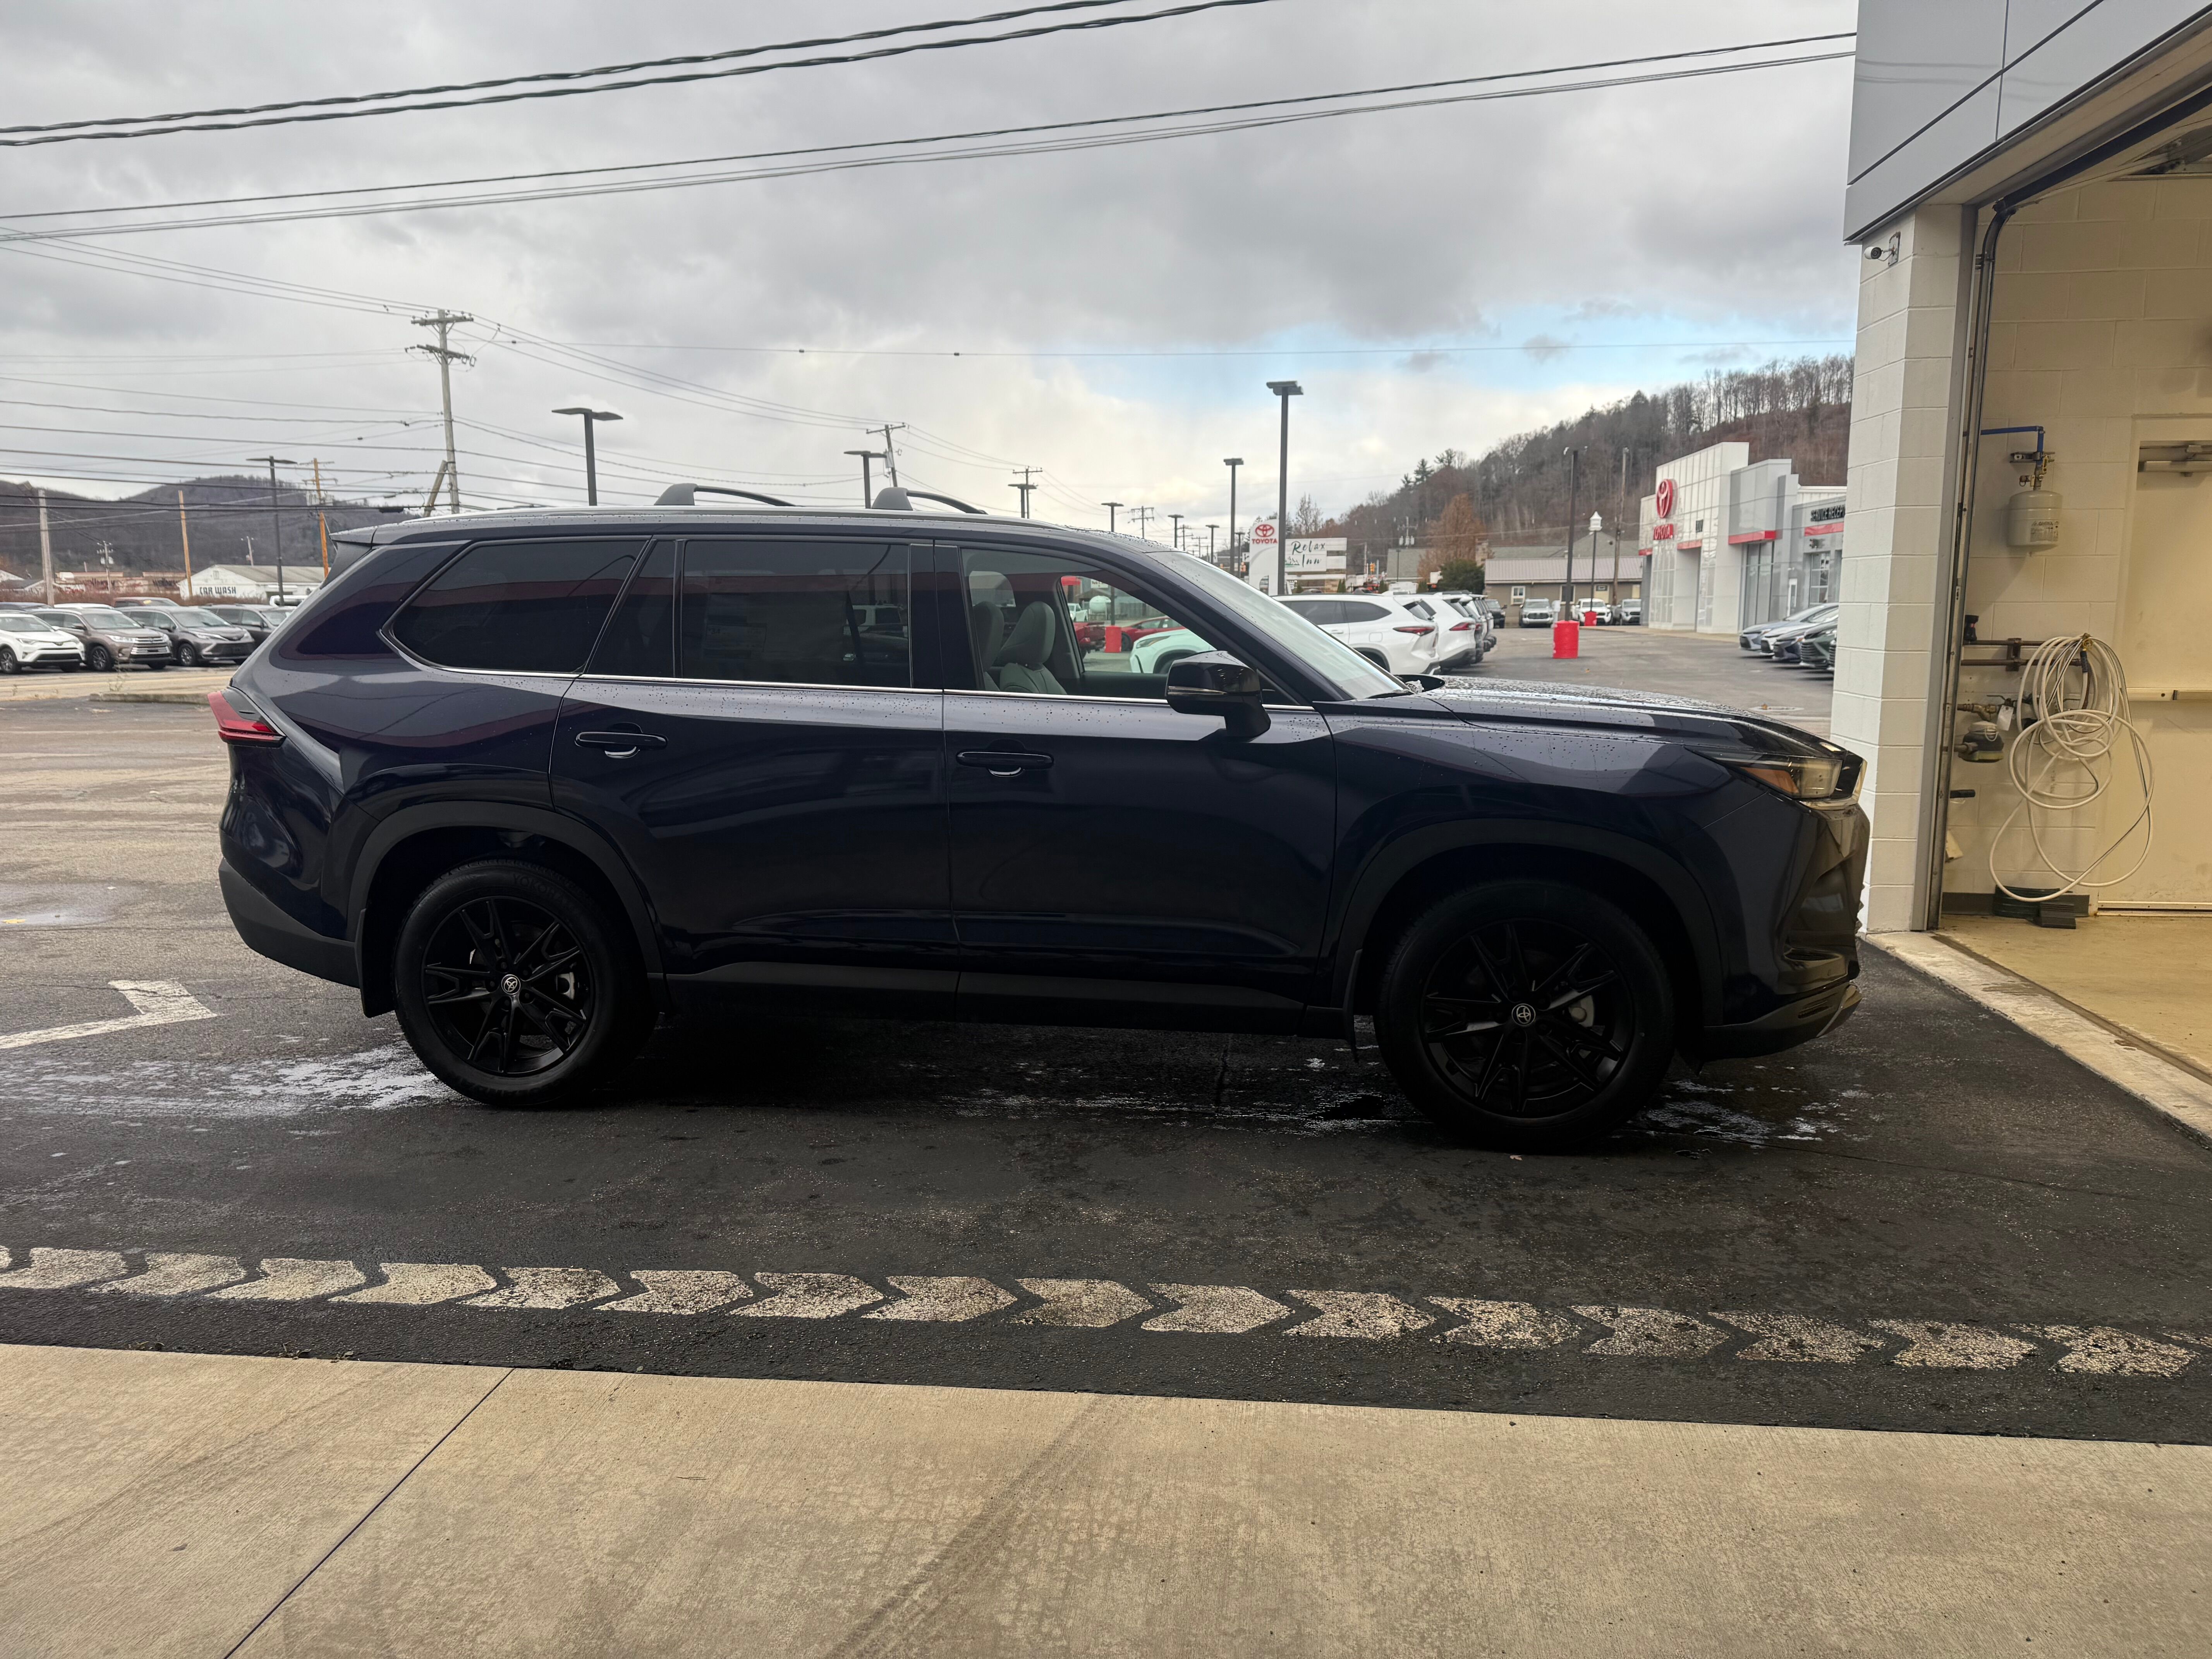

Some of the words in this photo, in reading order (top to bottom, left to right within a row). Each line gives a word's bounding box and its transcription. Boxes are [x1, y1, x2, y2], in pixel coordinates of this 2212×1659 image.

[1291, 541, 1325, 555] Relax
[1302, 554, 1321, 567] Inn
[199, 587, 213, 595] CAR
[215, 586, 236, 595] WASH
